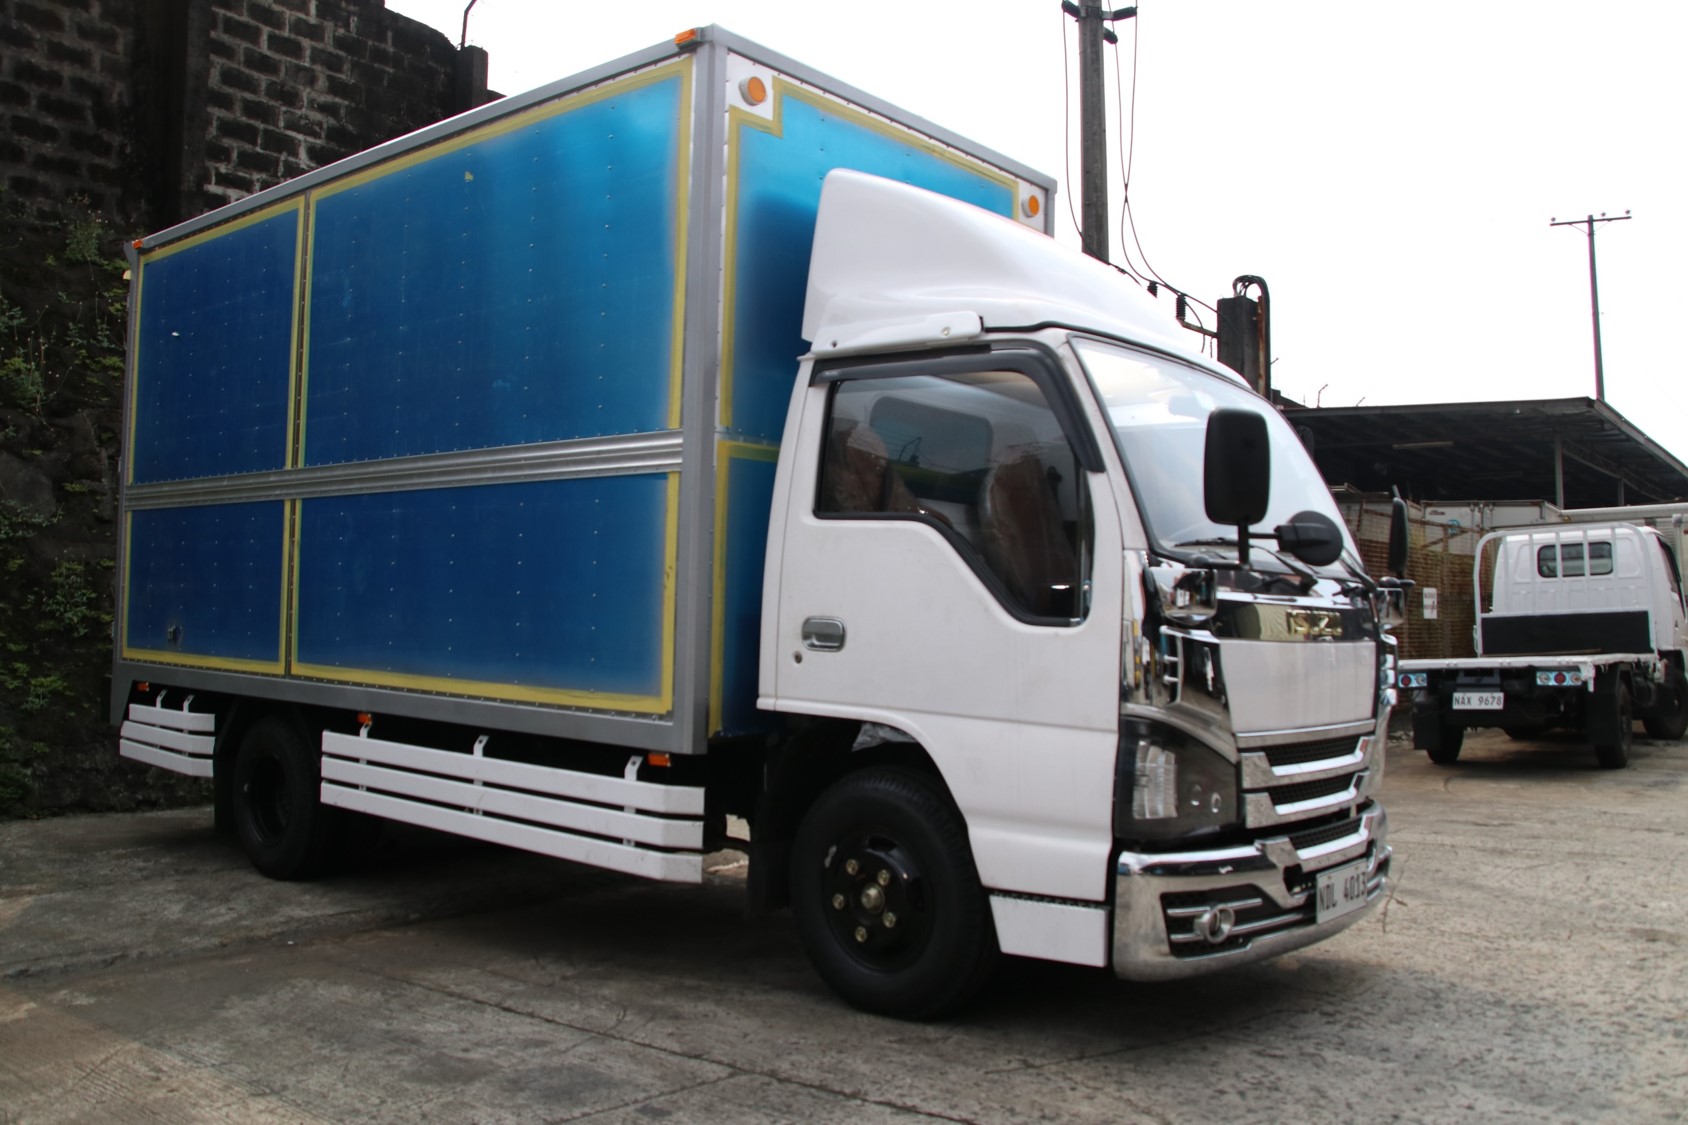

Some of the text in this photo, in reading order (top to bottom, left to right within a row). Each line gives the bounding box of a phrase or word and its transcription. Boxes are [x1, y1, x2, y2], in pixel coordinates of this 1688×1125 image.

[1454, 695, 1502, 706] NAX 9678
[1343, 872, 1366, 902] 4013
